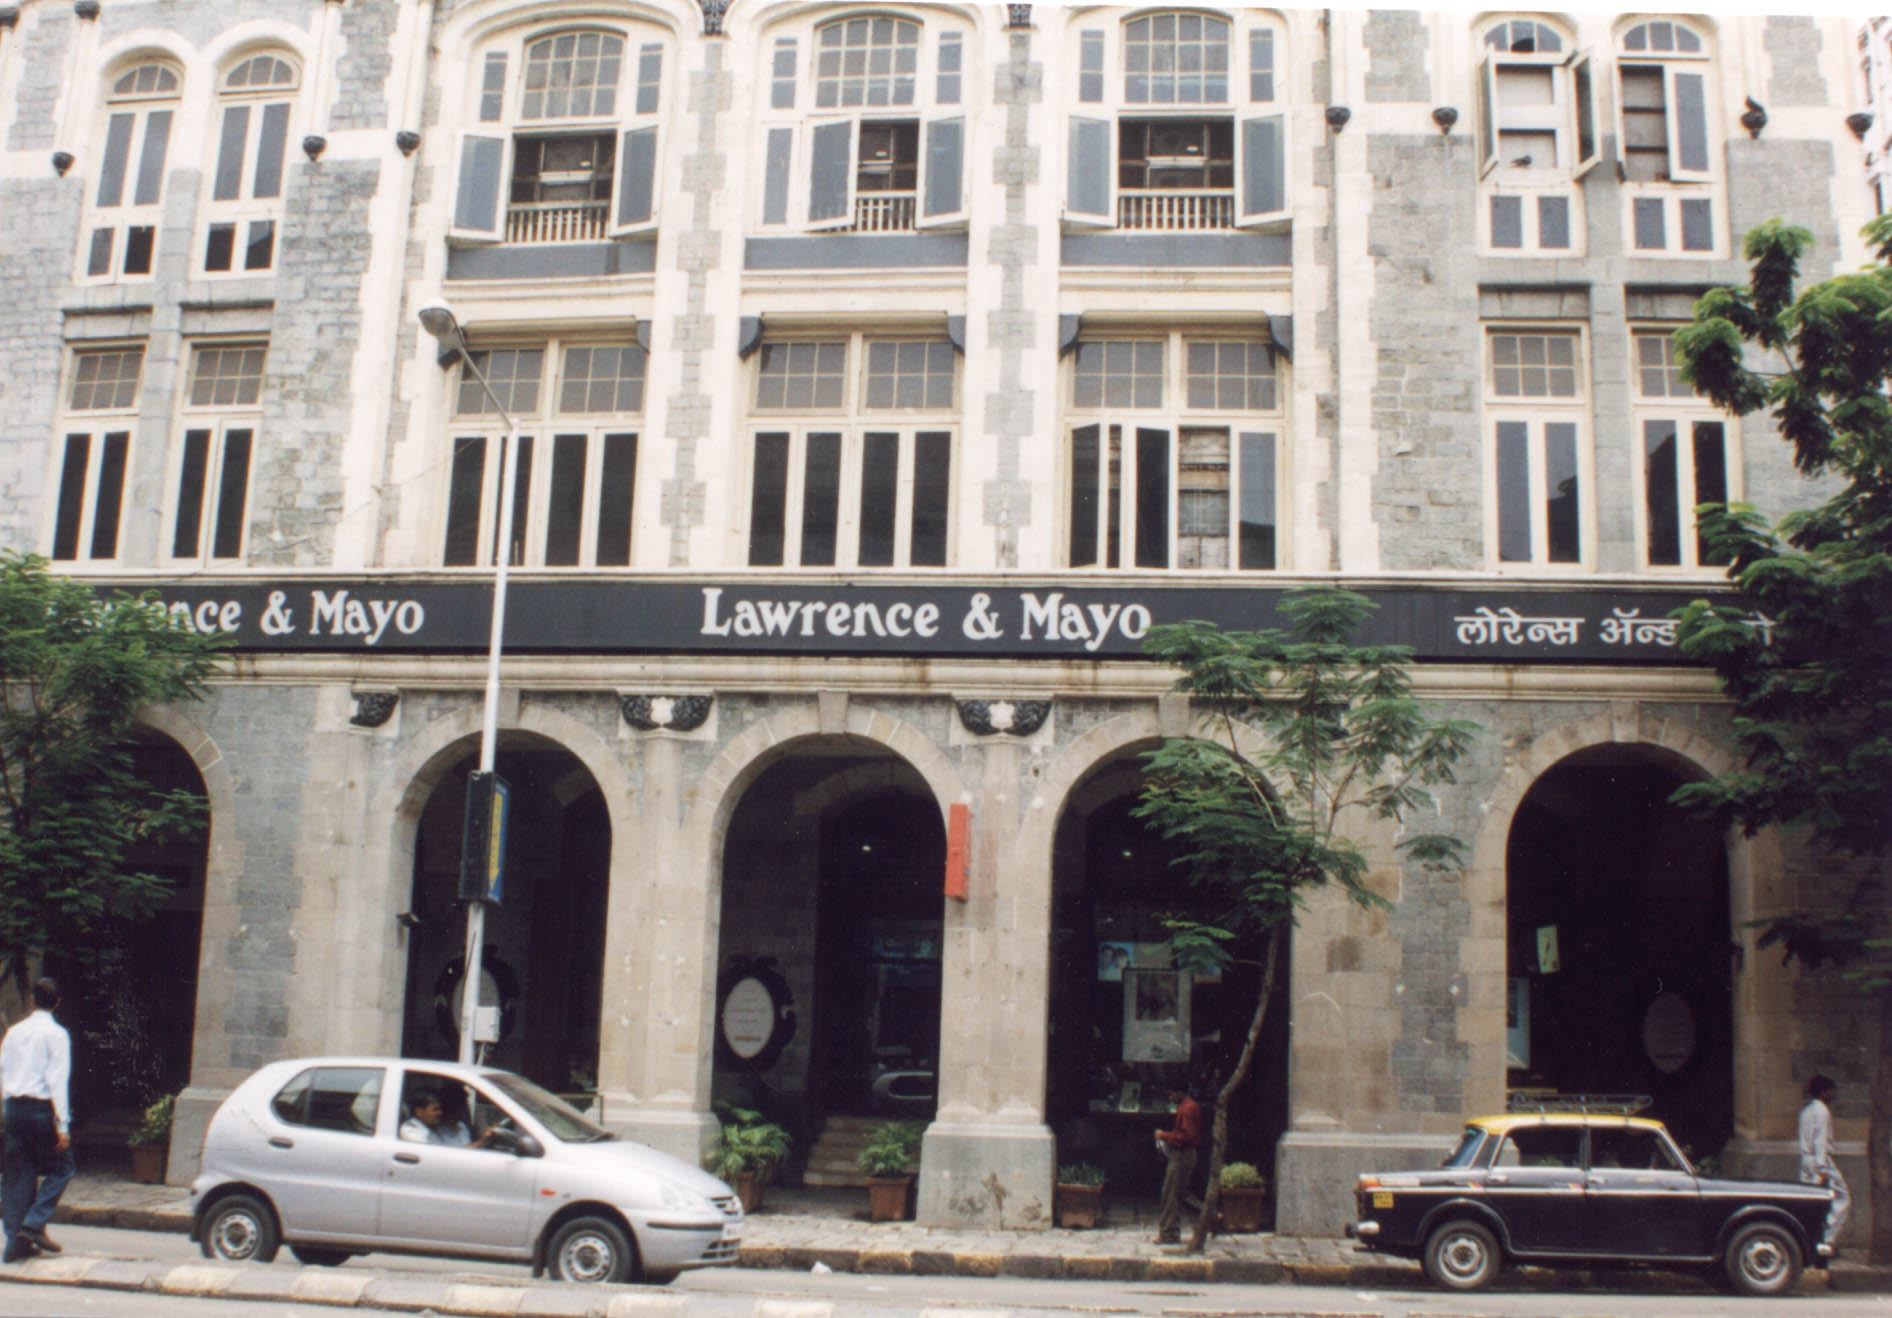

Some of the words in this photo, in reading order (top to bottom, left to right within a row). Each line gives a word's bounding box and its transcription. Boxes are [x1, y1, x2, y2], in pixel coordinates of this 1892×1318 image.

[260, 590, 296, 635] &
[308, 590, 425, 645] Mayo
[701, 587, 939, 637] Lawrence
[962, 592, 1003, 640] &
[1019, 593, 1151, 651] Mayo
[1453, 607, 1585, 645] लोरेन्स
